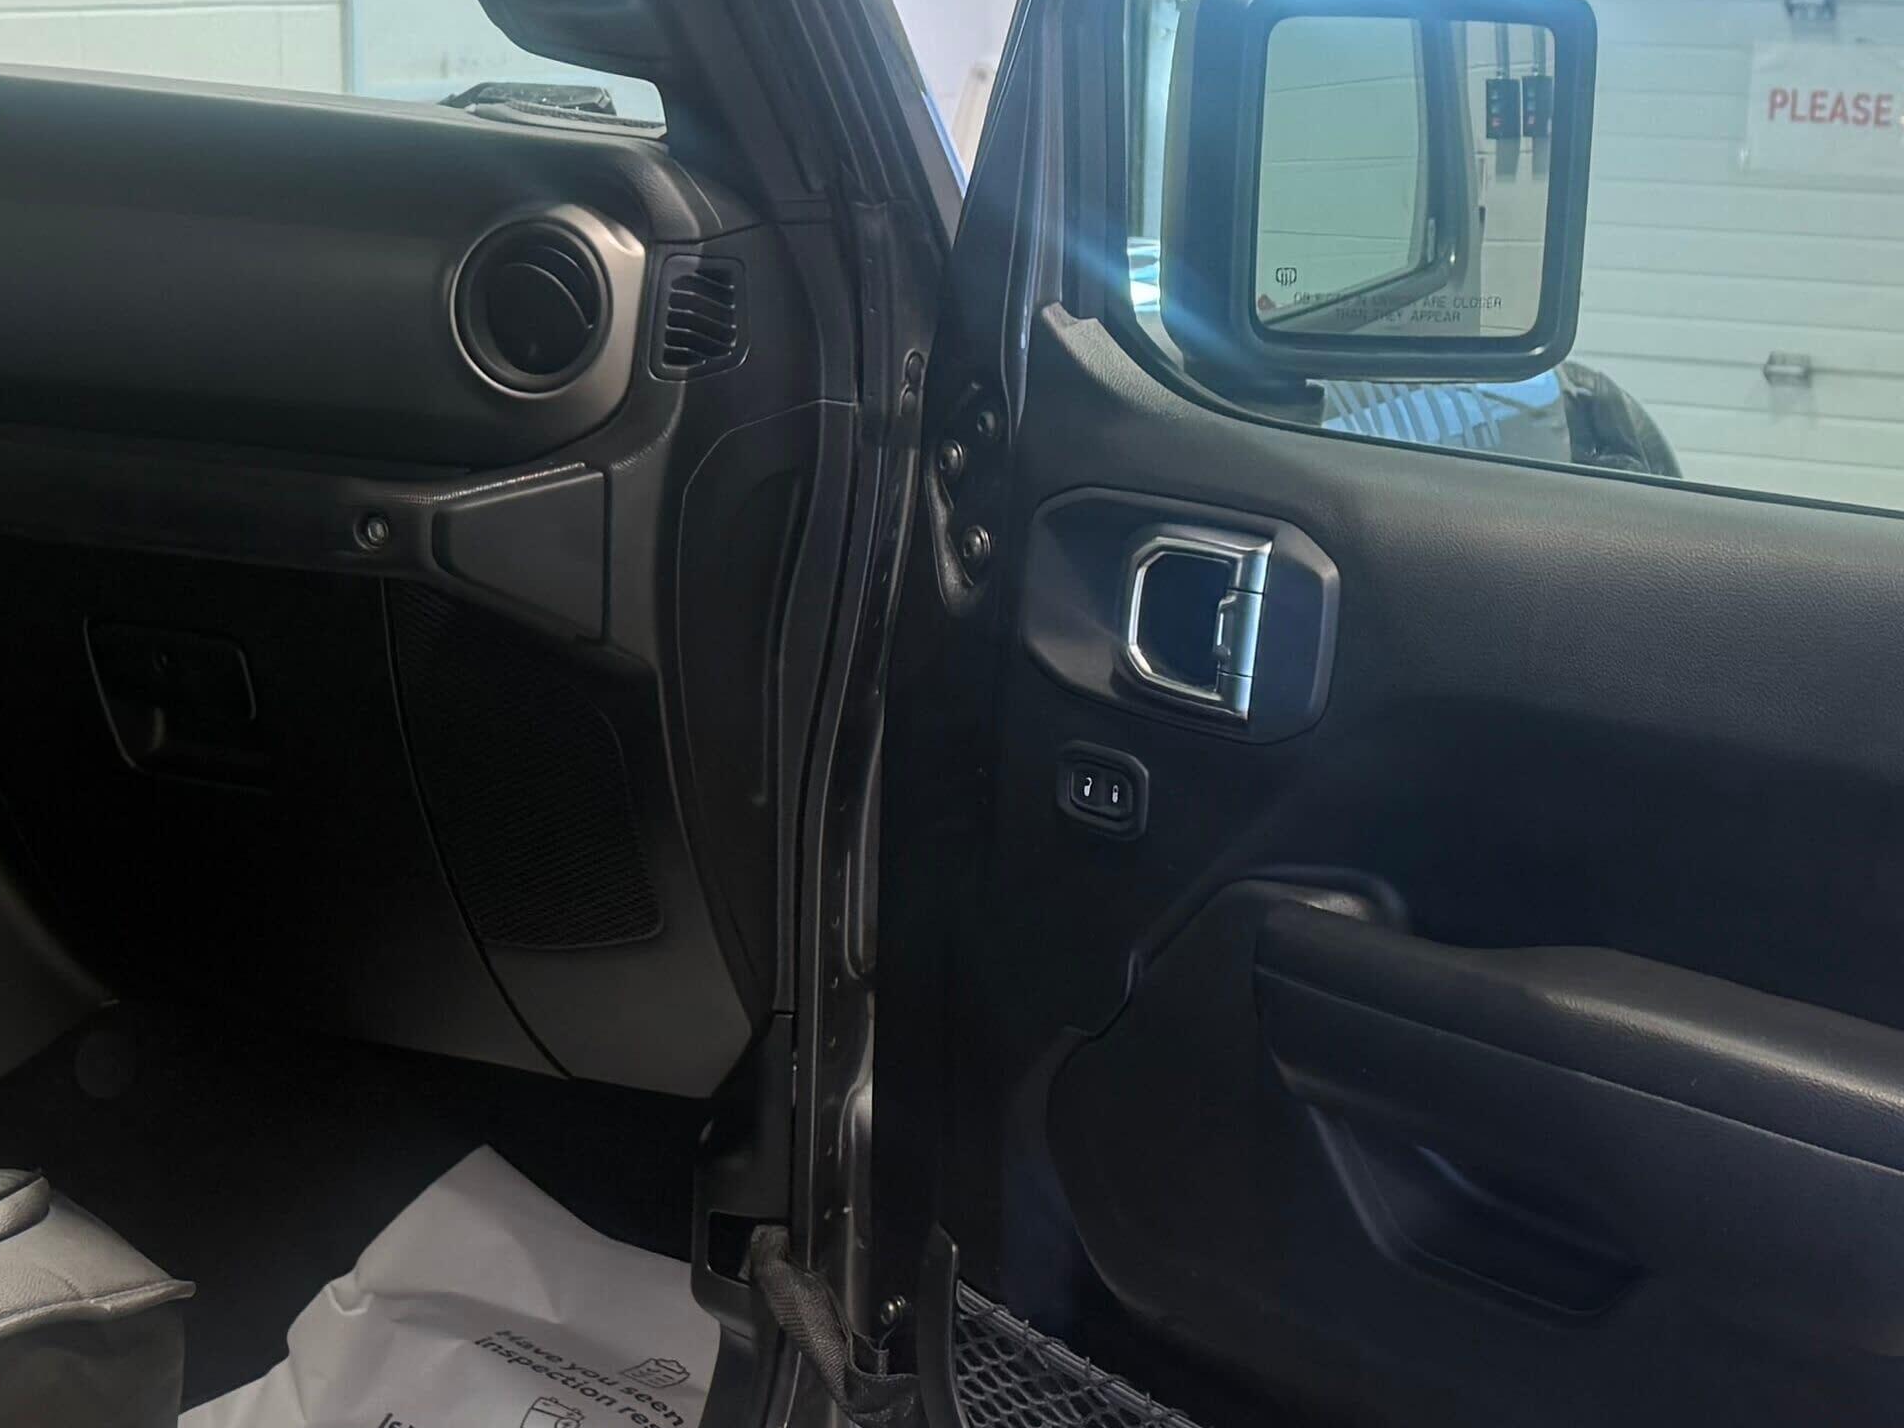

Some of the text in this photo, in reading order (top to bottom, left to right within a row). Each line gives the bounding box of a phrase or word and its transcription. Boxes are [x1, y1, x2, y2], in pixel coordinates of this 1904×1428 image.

[1767, 87, 1895, 128] PLEASE
[473, 1335, 617, 1409] inspection
[496, 1329, 563, 1364] Have
[560, 1361, 620, 1387] you
[619, 1386, 684, 1427] seen
